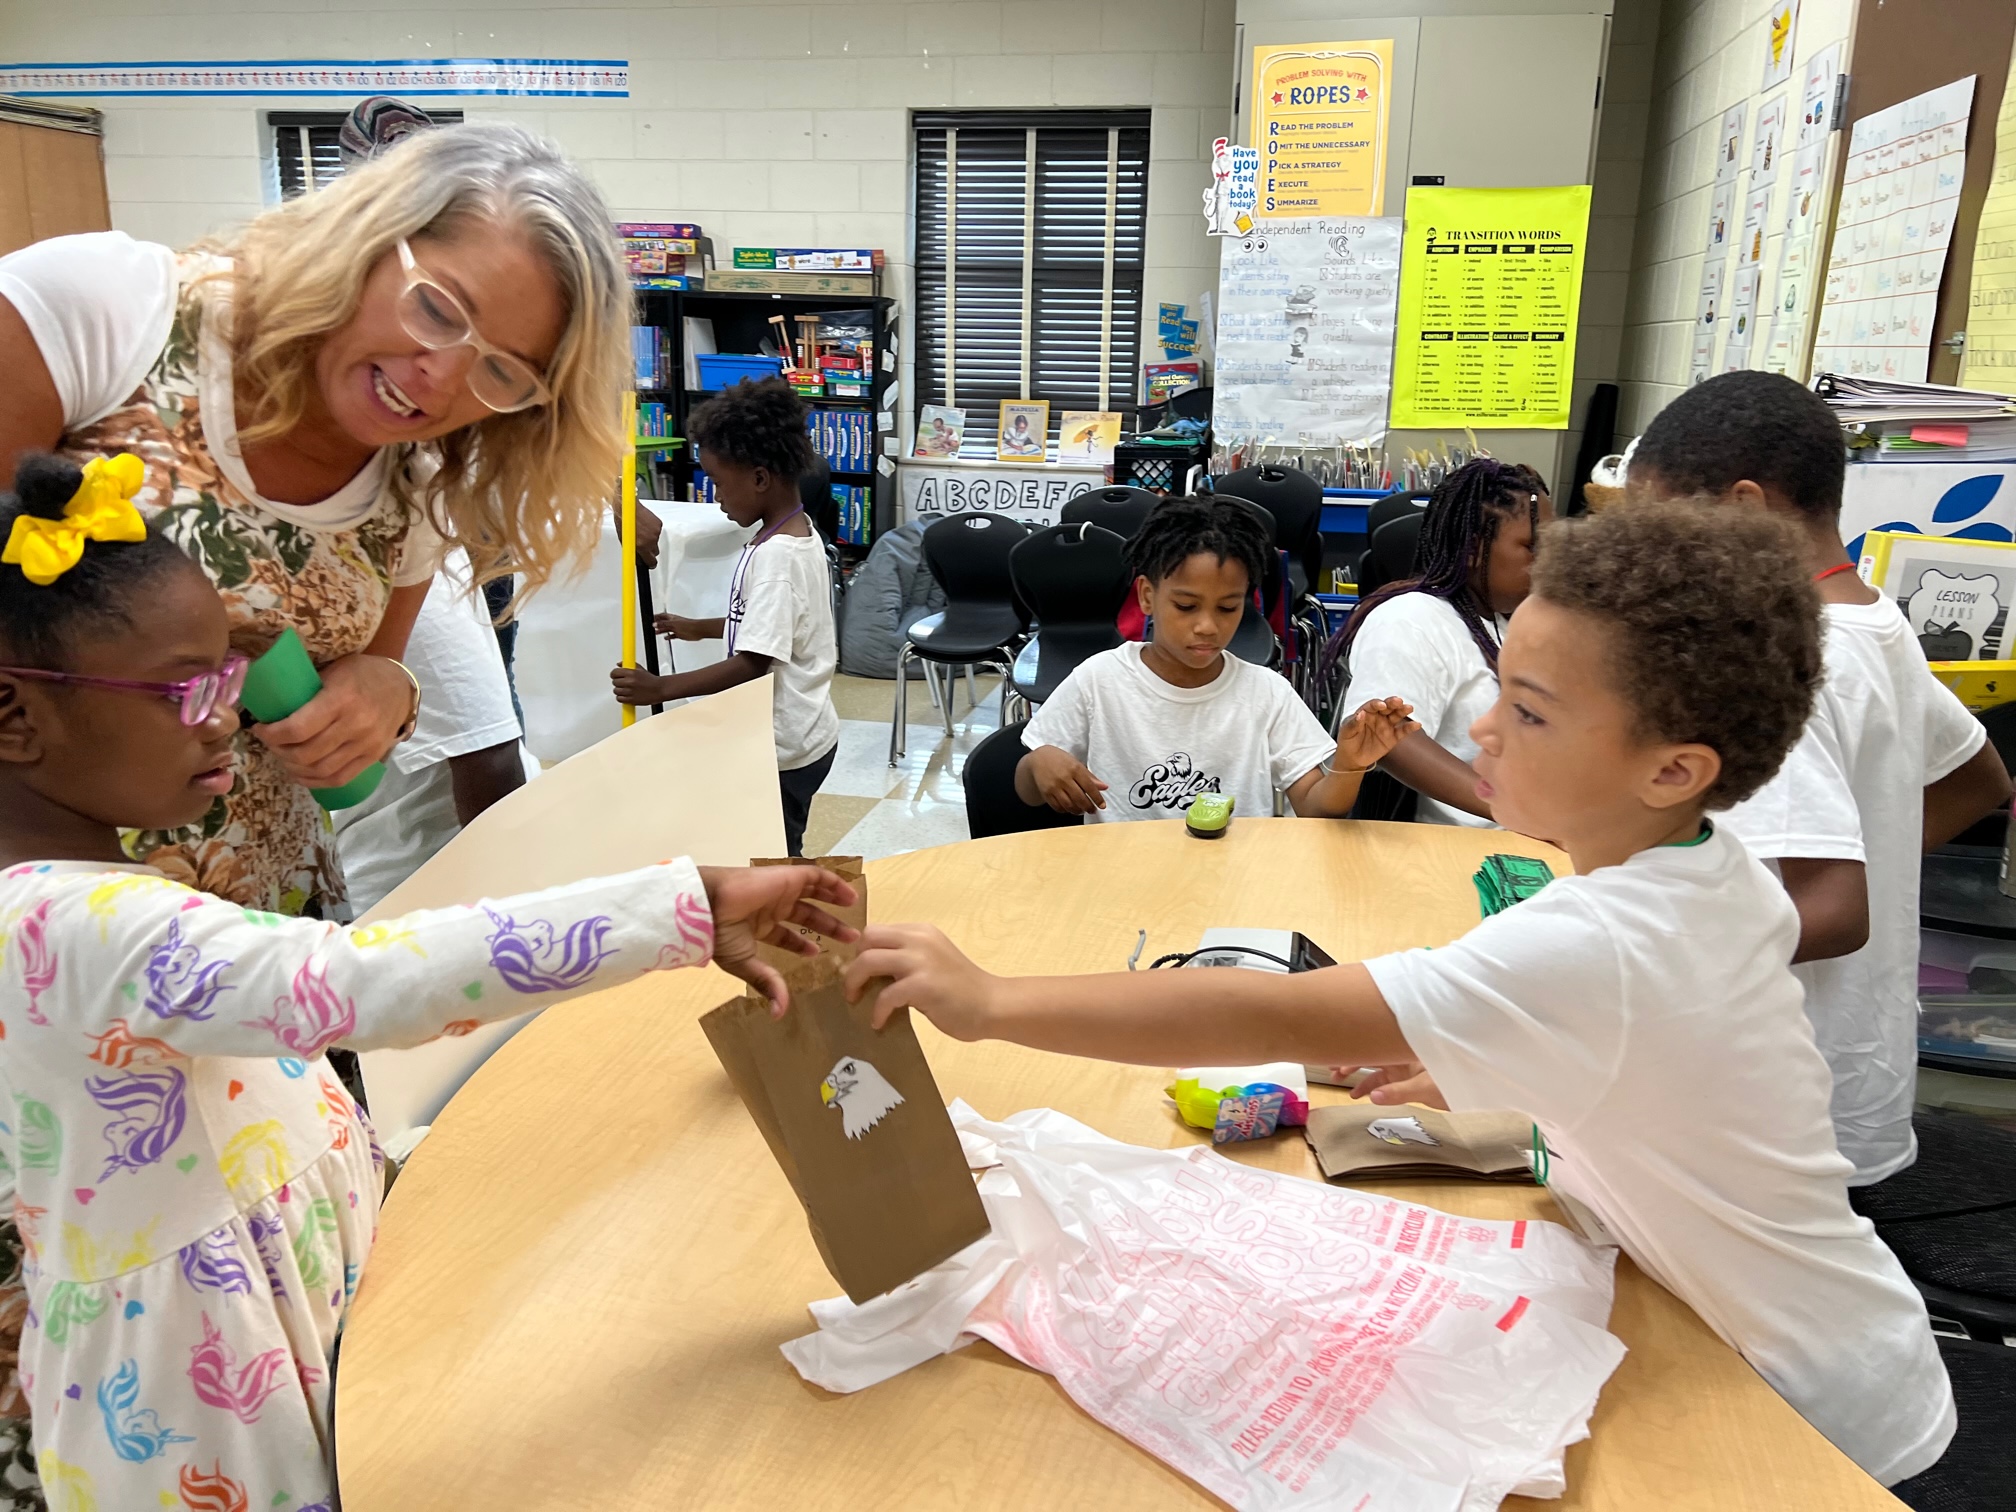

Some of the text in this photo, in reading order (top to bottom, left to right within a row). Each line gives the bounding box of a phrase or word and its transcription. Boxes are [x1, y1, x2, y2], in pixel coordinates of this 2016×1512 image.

[1276, 70, 1367, 86] PROBLEM SOLVING WITH
[1290, 86, 1350, 105] ROPES
[1316, 122, 1354, 130] PROBLEM
[1312, 141, 1370, 149] UNNECESSARY
[1232, 148, 1256, 158] Have
[1234, 161, 1258, 174] you
[1232, 173, 1254, 183] read
[1230, 189, 1256, 199] book
[1230, 199, 1256, 210] today?
[1318, 220, 1366, 238] Reading
[1445, 230, 1562, 240] TRANSITION WORDS
[1160, 316, 1181, 326] Read
[1936, 590, 1980, 604] LESSON
[1931, 604, 1974, 620] PLANS
[1129, 764, 1221, 810] Eagles
[1240, 1098, 1260, 1138] SQUISHY
[1399, 1208, 1427, 1242] RECYCLING
[1231, 1420, 1274, 1460] PLEASE
[1289, 1375, 1313, 1392] TO
[1383, 1263, 1427, 1307] RECYCLING
